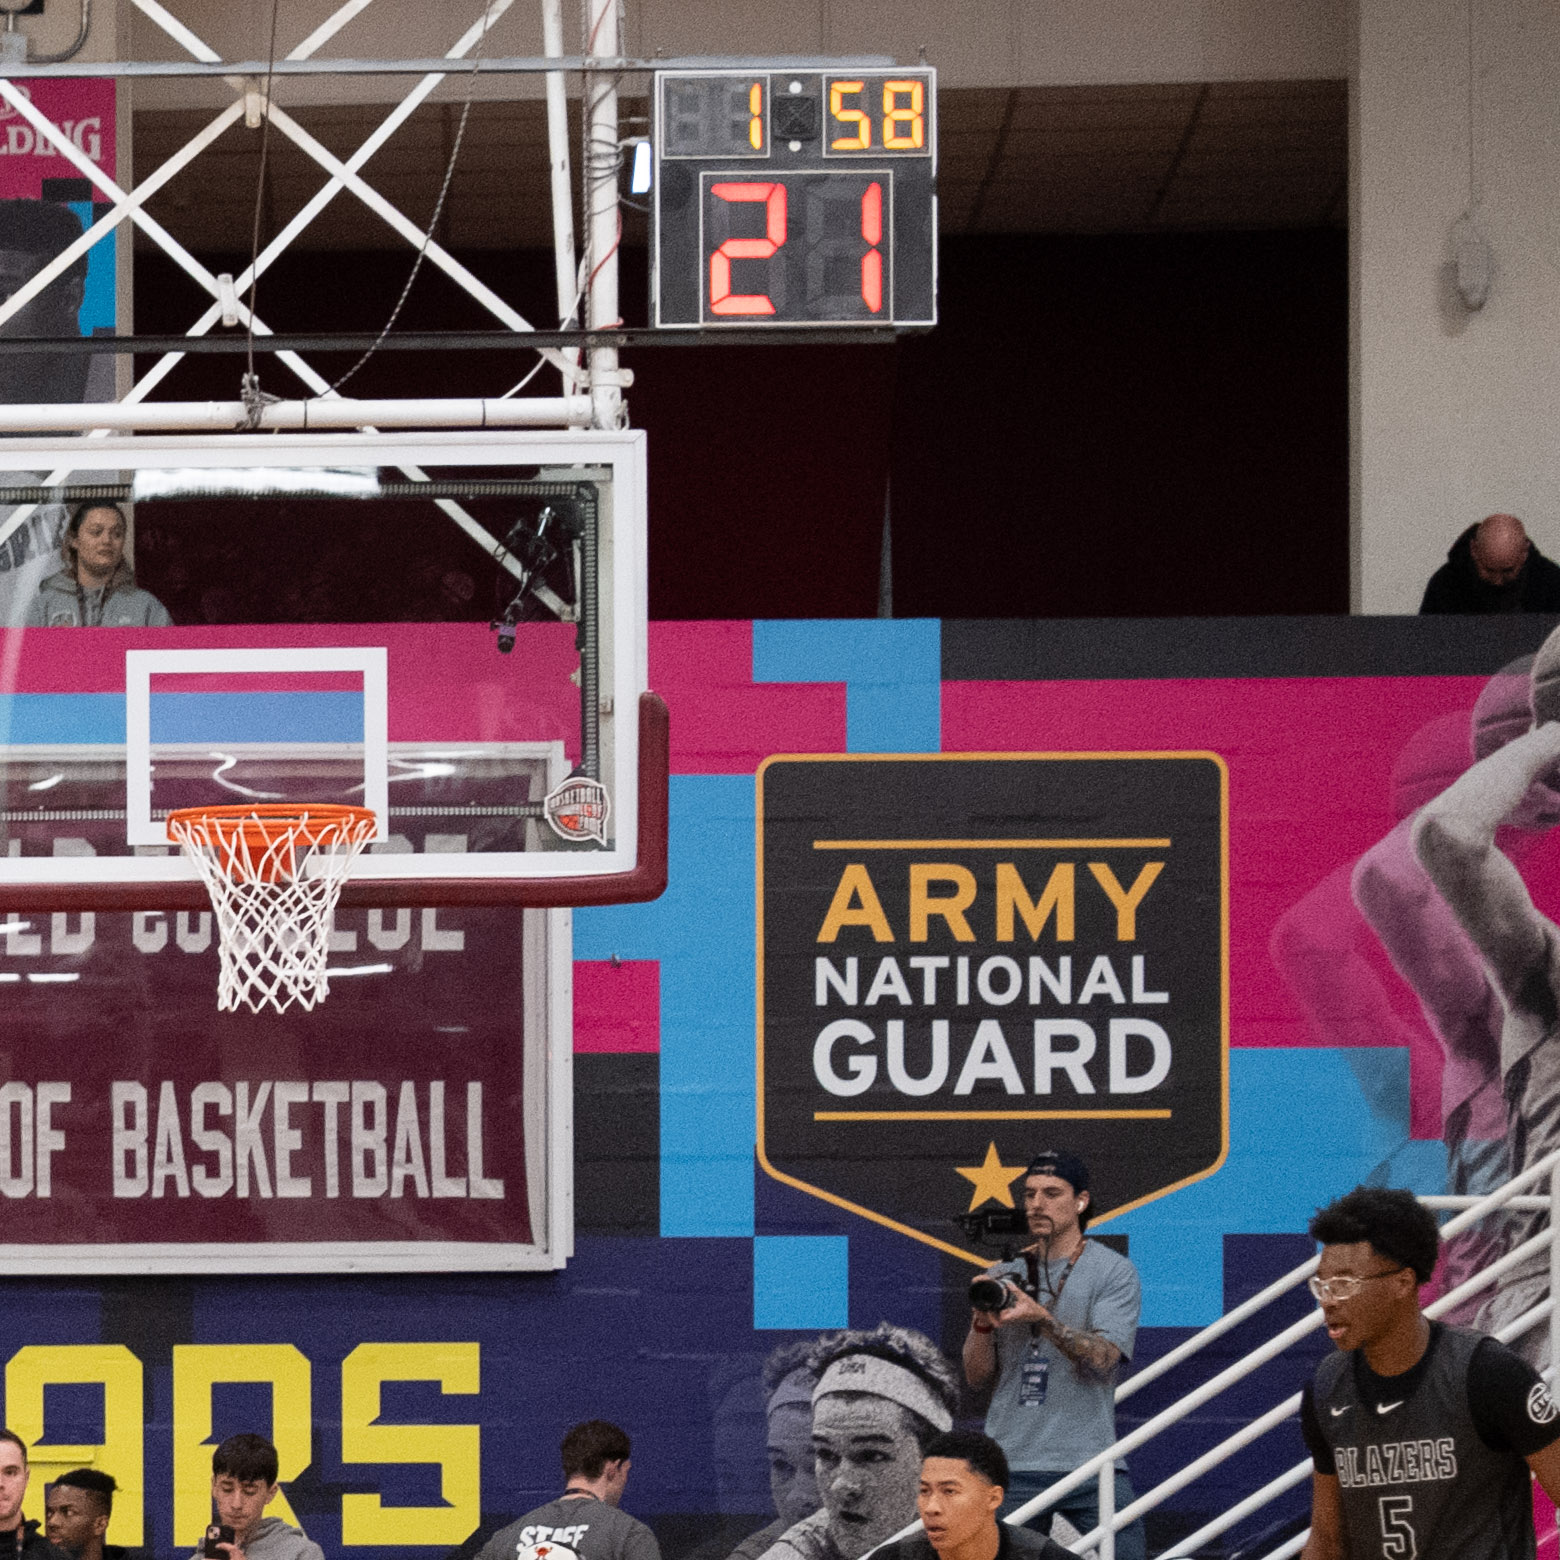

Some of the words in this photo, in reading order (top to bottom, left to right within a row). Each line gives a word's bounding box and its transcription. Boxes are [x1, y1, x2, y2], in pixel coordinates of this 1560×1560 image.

[710, 182, 882, 315] 21
[817, 862, 1165, 942] ARMY
[815, 955, 1170, 1005] NATIONAL
[813, 1019, 1172, 1096] GUARD
[110, 1080, 506, 1199] BASKETBALL
[1336, 1438, 1457, 1487] BLAZERS
[516, 1524, 589, 1552] STAFF
